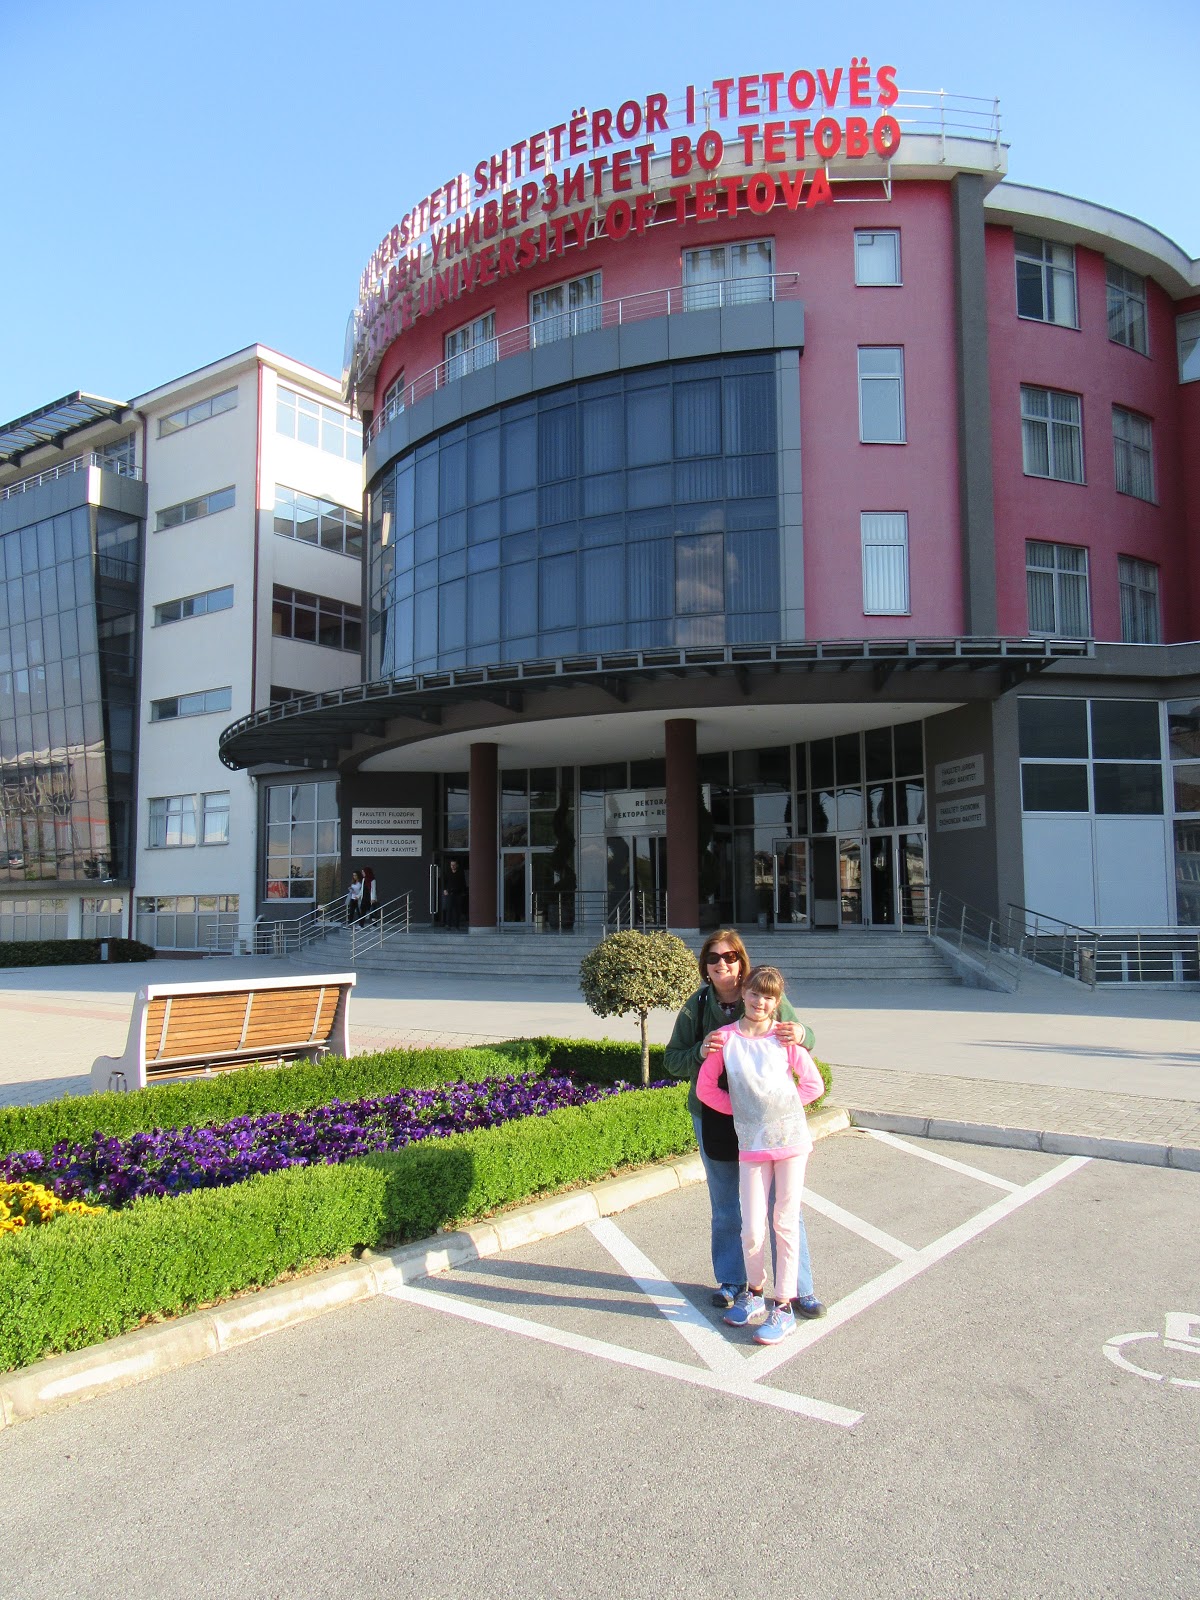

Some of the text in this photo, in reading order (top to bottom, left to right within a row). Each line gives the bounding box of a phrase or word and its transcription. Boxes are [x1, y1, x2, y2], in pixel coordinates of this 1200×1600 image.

[431, 143, 655, 267] УНИВЕРЗИТЕТ
[738, 115, 901, 166] ТЕТОВО
[474, 91, 668, 198] SHTETËROR
[686, 85, 695, 125] I
[712, 57, 899, 119] TETOVËS
[418, 206, 592, 319] UNIVERSITY
[605, 192, 656, 241] OF
[670, 168, 834, 224] TETOVA
